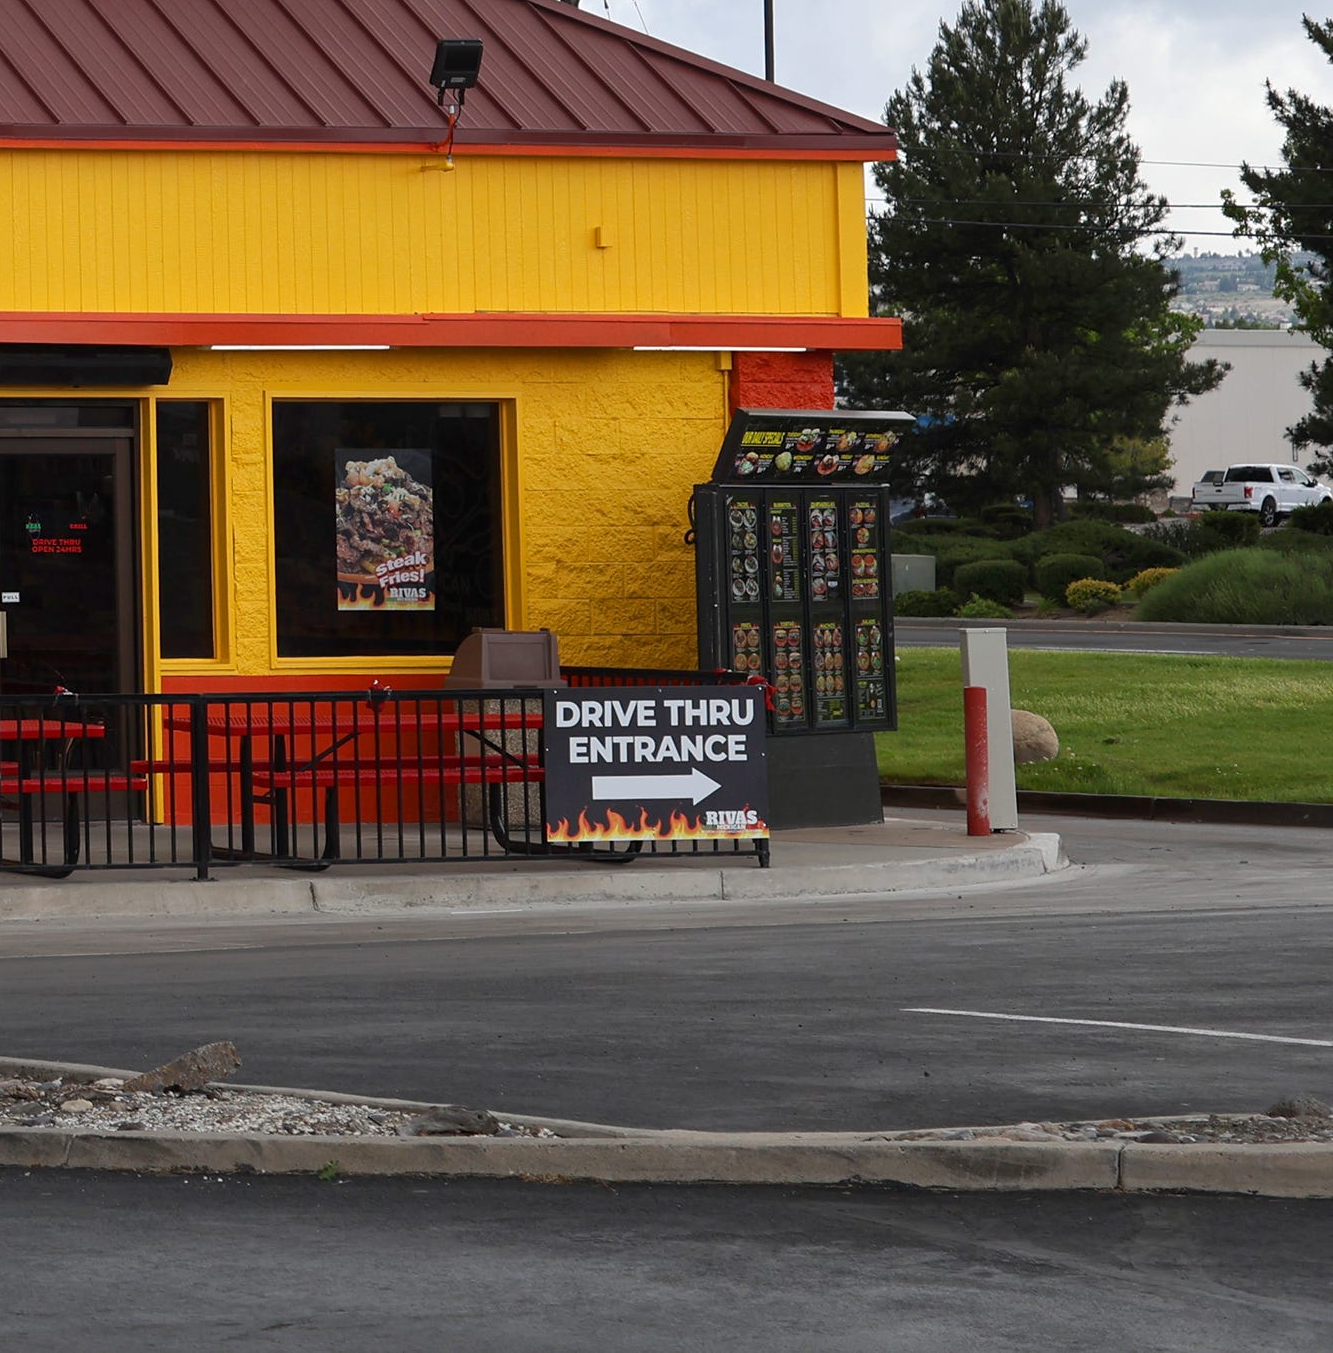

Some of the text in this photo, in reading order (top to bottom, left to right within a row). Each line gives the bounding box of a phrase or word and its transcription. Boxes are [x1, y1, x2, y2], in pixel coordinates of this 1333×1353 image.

[376, 551, 427, 576] Steak
[379, 568, 424, 588] Fries!
[389, 587, 427, 597] RIVAS
[555, 698, 755, 728] DRIVE THRU
[569, 734, 748, 764] ENTRANCE
[705, 810, 758, 825] RIVAS
